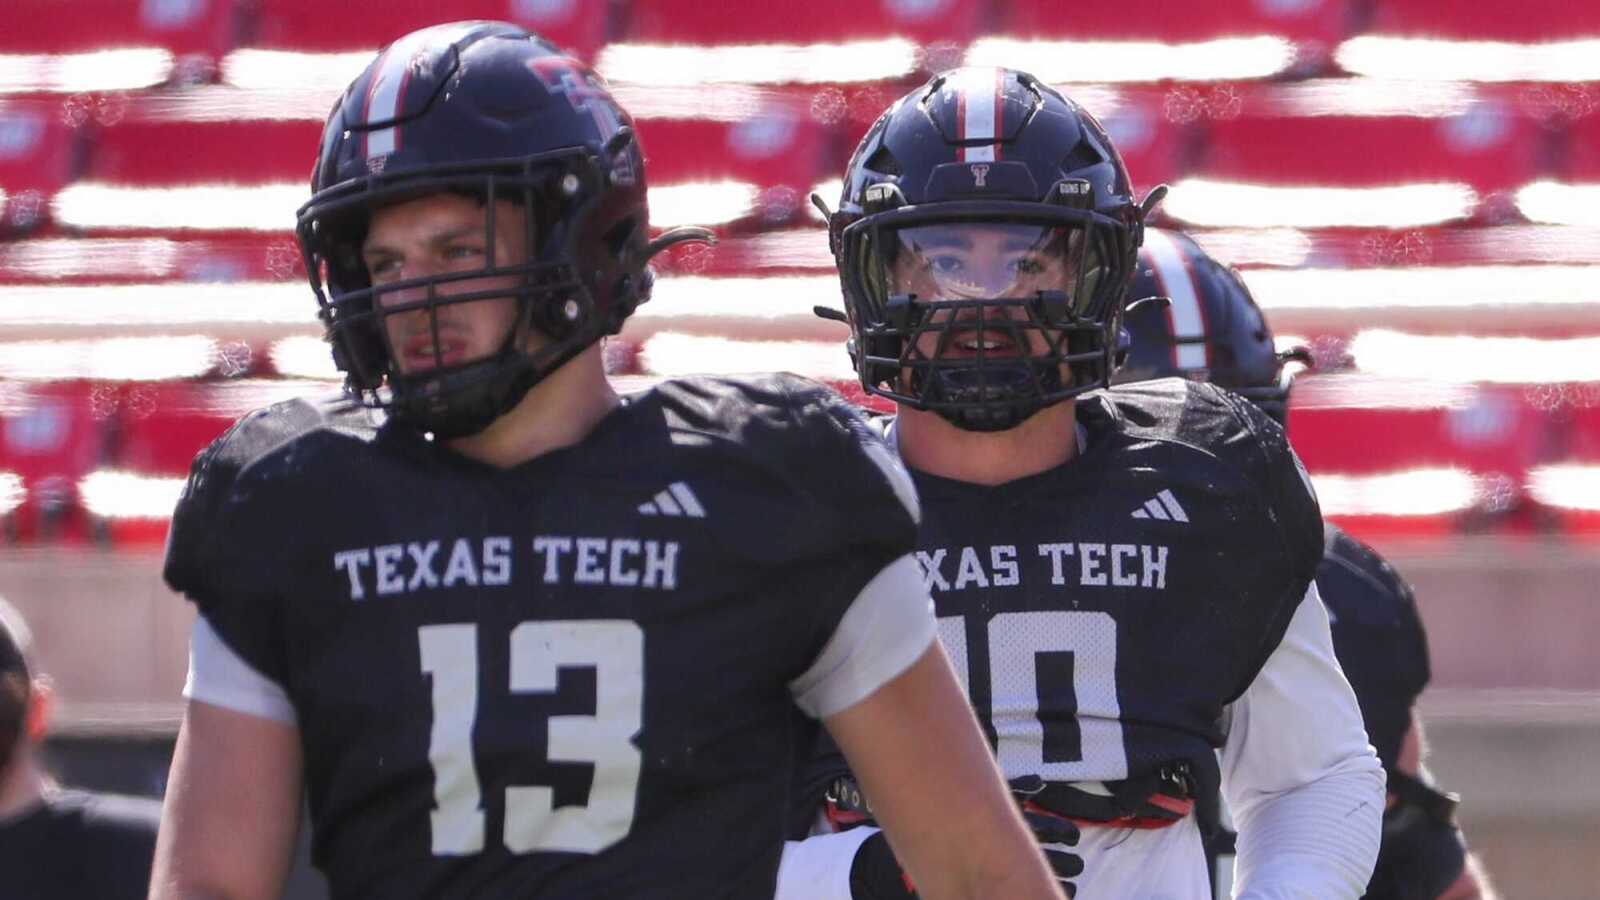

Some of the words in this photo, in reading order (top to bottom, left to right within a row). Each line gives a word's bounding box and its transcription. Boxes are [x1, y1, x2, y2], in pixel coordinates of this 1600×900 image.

[334, 537, 511, 600] TEXAS
[533, 536, 680, 590] TECH
[916, 545, 1020, 592] XAS
[1038, 542, 1169, 589] TECH
[417, 619, 645, 856] 13
